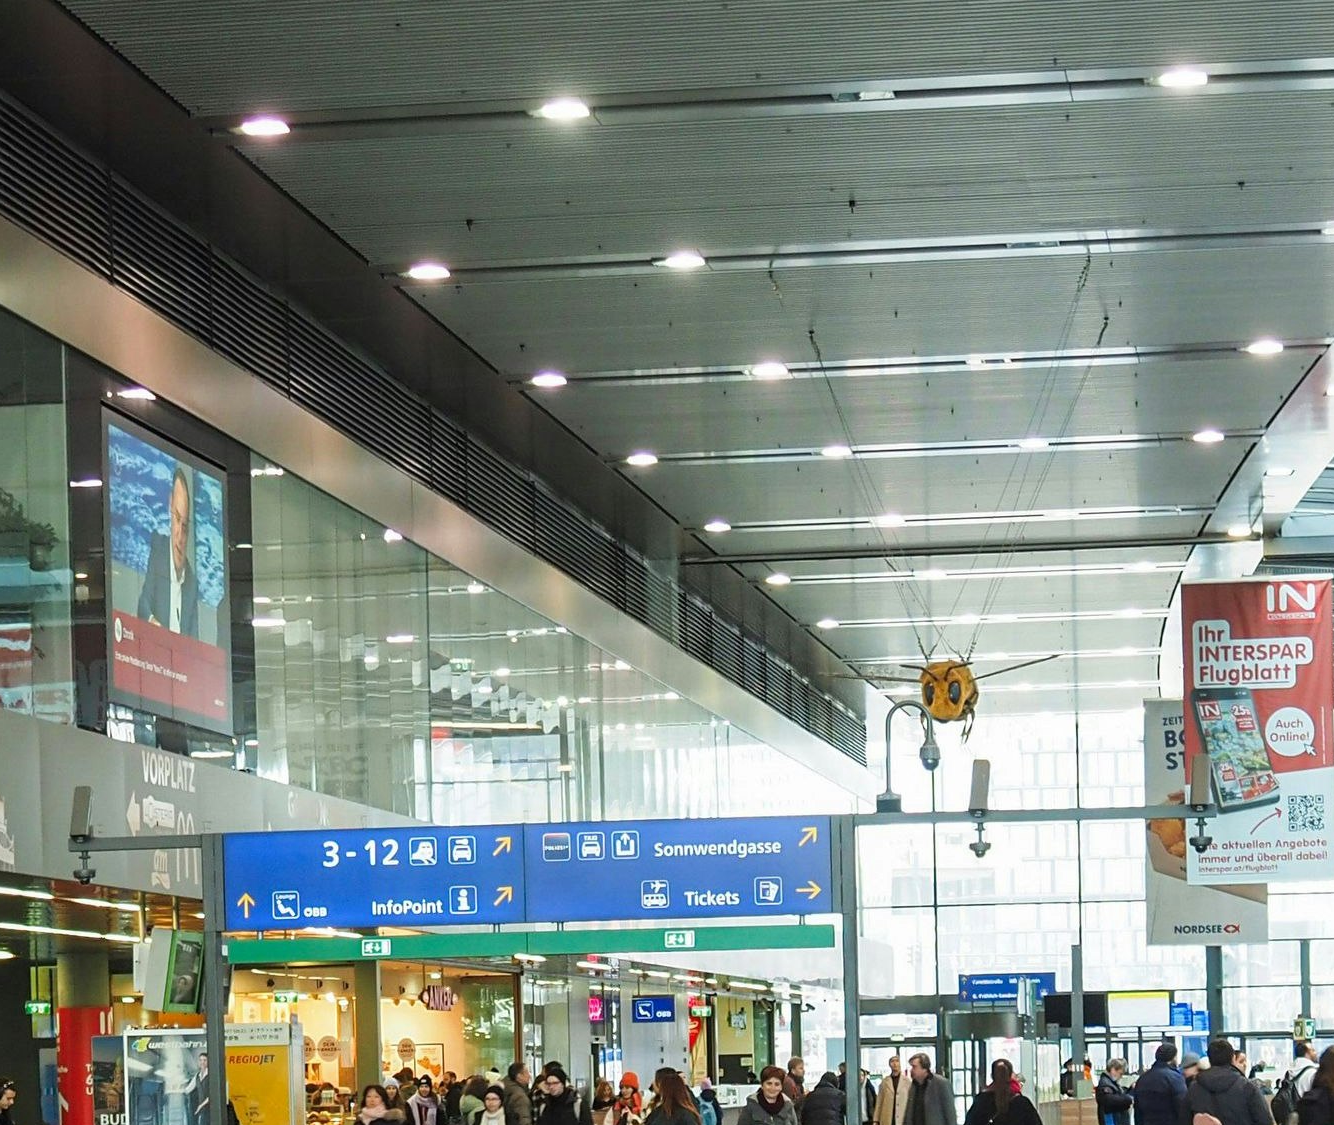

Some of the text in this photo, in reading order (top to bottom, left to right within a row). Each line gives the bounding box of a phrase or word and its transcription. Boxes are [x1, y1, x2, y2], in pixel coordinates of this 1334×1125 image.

[1266, 583, 1316, 612] IN
[1199, 626, 1225, 642] Ihr
[1199, 643, 1307, 662] INTERSPAR
[1199, 664, 1291, 685] Flugblatt
[1199, 703, 1221, 717] IN
[1276, 719, 1304, 729] Auch
[1270, 732, 1310, 743] Online!
[141, 750, 196, 793] VORPLATZ
[654, 839, 781, 858] Sonnwendgasse
[1221, 840, 1272, 850] aktuellen
[1275, 839, 1328, 850] Angebote
[1198, 851, 1328, 864] immer und überall dabei!
[684, 890, 740, 906] Tickets
[372, 899, 443, 916] InfoPoint
[1174, 924, 1222, 934] NORDSEE
[427, 985, 452, 1011] ANKER
[229, 1055, 275, 1064] REGIOJET
